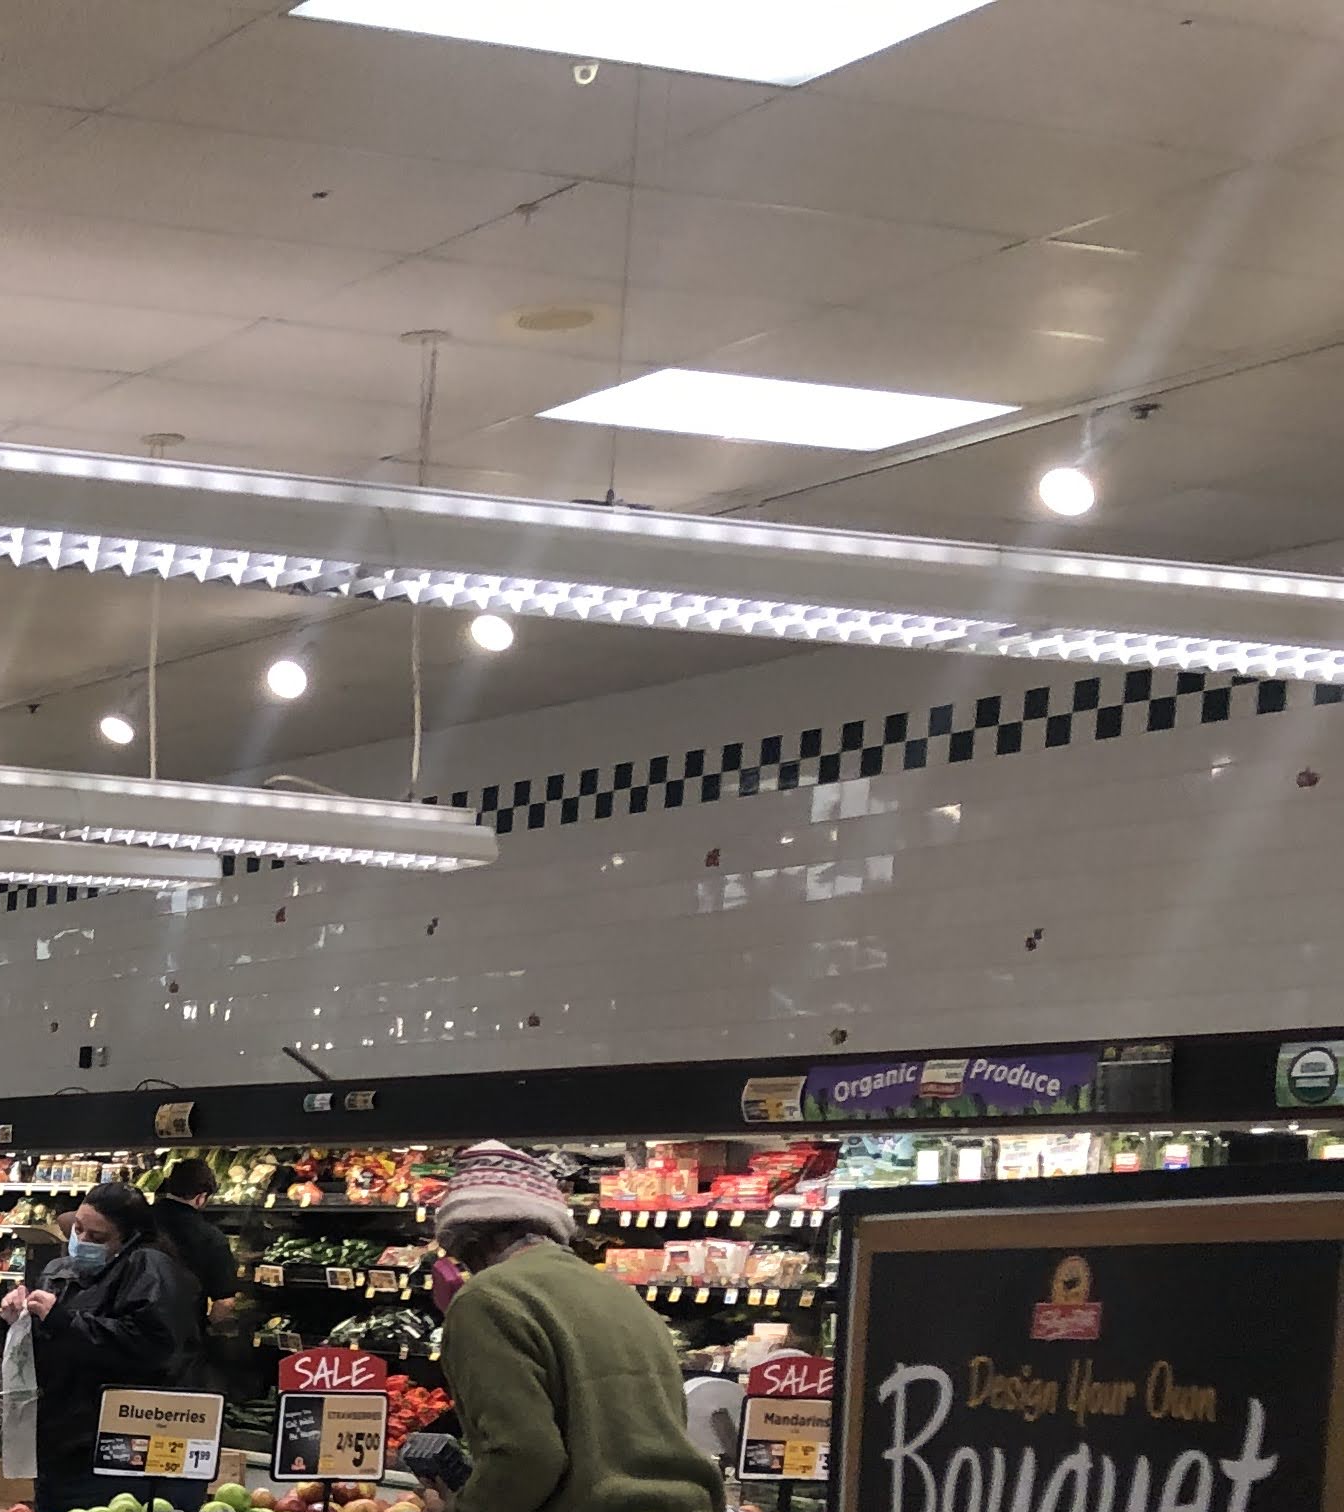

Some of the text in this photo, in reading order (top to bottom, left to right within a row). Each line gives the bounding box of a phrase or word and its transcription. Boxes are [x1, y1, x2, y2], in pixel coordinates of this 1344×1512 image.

[834, 1061, 919, 1102] Organic
[969, 1057, 1061, 1097] Produce
[294, 1356, 376, 1389] SALE
[763, 1364, 833, 1396] SALE
[967, 1356, 1217, 1427] Design Your Own
[118, 1404, 207, 1424] Blueberries
[764, 1412, 831, 1428] Mandarins
